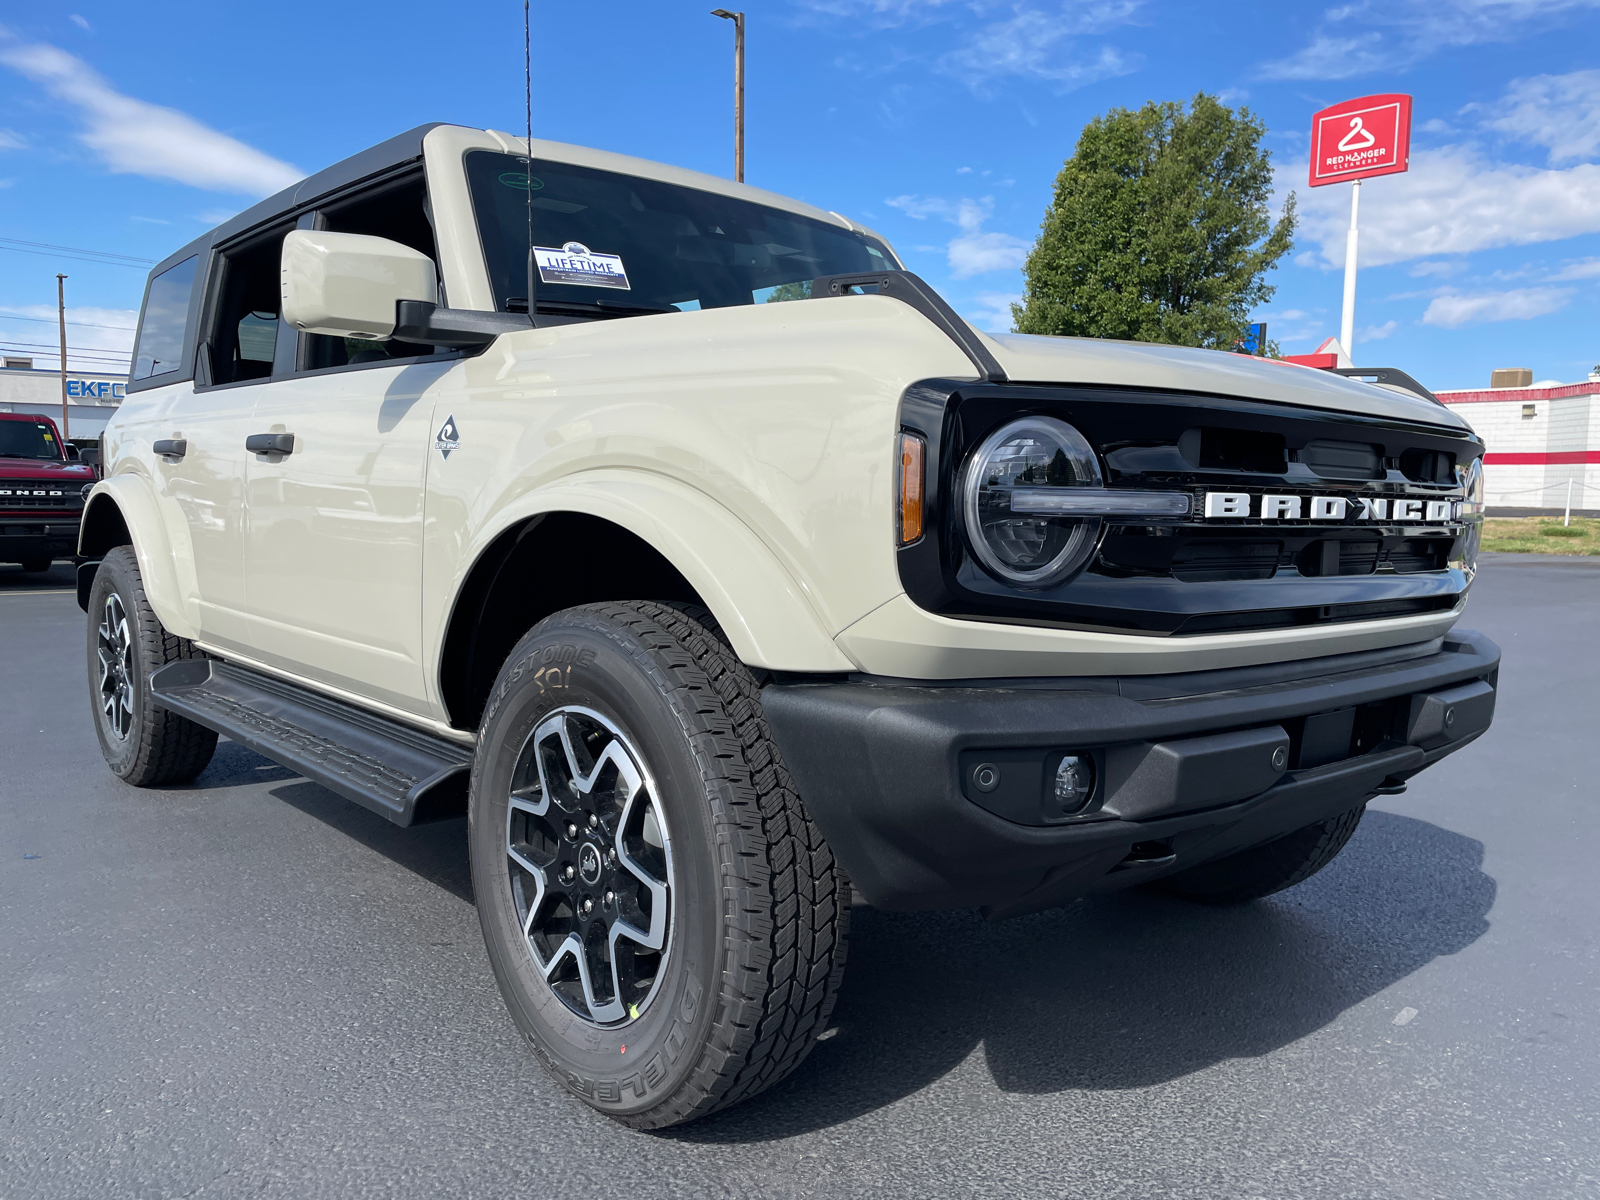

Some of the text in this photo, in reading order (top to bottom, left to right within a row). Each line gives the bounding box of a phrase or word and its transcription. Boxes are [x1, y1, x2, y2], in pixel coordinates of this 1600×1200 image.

[1327, 148, 1386, 165] RED HANGER
[1334, 158, 1377, 169] CLEANERS
[547, 257, 614, 273] LIFETIME
[567, 968, 703, 1102] DUELER
